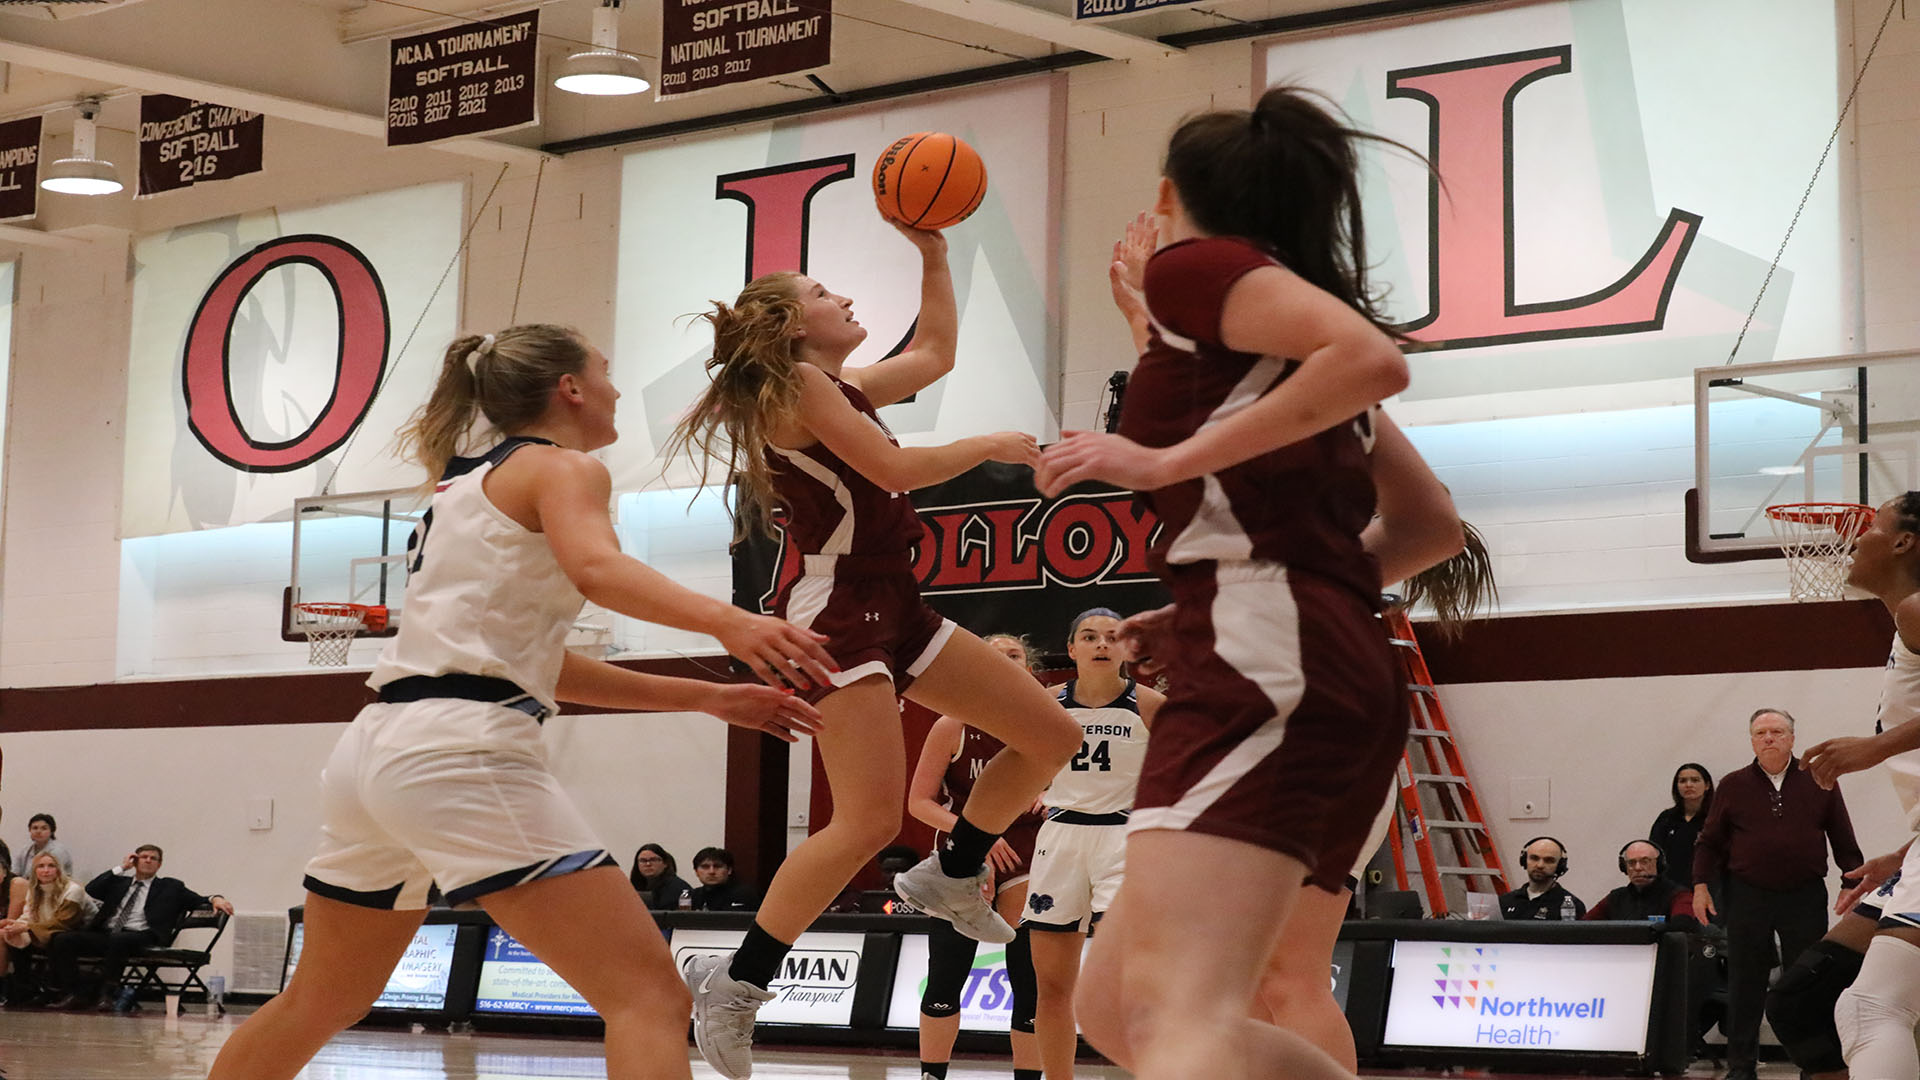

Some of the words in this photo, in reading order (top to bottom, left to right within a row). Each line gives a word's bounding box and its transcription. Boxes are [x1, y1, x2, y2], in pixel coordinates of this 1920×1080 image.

[693, 0, 799, 32] SOFTBALL
[395, 42, 435, 66] NCAA
[437, 21, 532, 57] TOURNAMENT
[670, 35, 731, 65] NATIONAL
[736, 15, 821, 51] TOURNAMENT
[415, 55, 510, 87] SOFTBALL
[662, 71, 687, 87] 2010
[692, 64, 719, 82] 2013
[724, 58, 751, 75] 2017
[425, 89, 452, 109] 2011
[459, 82, 489, 101] 2012
[494, 74, 525, 95] 2013
[140, 109, 203, 142] CONFERENCE
[389, 111, 419, 128] 2016
[424, 104, 452, 124] 2017
[457, 98, 487, 117] 2021
[0, 145, 37, 169] AMPIONS
[159, 128, 240, 163] SOFTBALL
[178, 155, 218, 182] 216
[877, 137, 915, 196] Wilson
[182, 233, 391, 474] O
[1386, 43, 1704, 355] L
[1081, 724, 1132, 739] ERSON
[1070, 739, 1112, 772] 24
[890, 901, 915, 914] POSS
[534, 1003, 597, 1014] www.mercymedic
[779, 983, 846, 1008] Transport
[1480, 996, 1605, 1018] Northwell
[1475, 1023, 1553, 1046] Health
